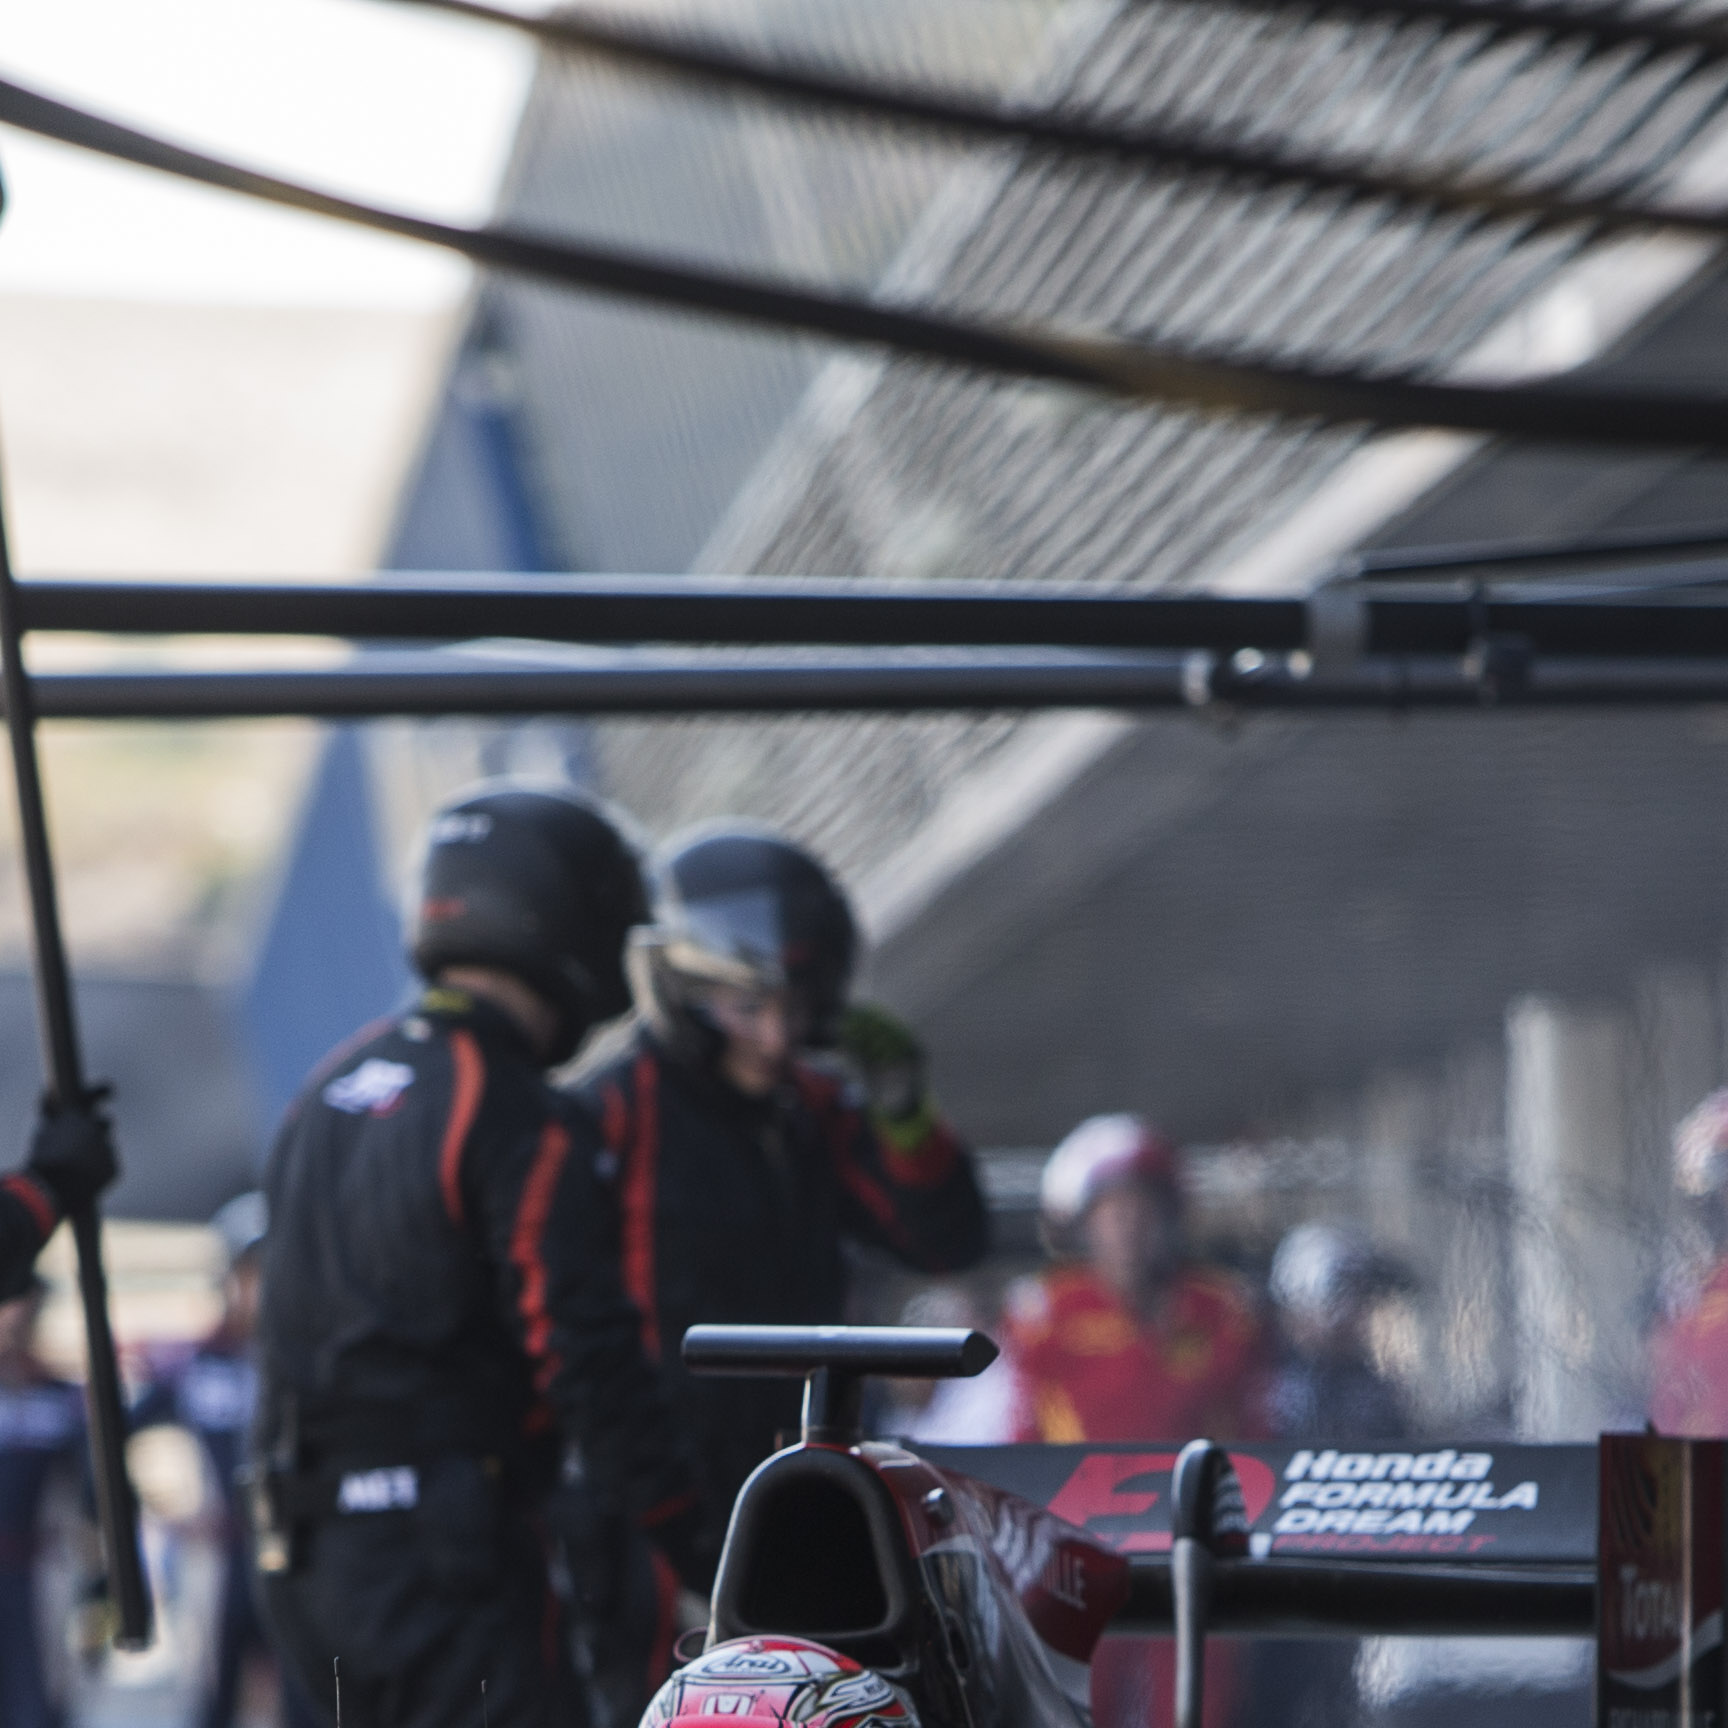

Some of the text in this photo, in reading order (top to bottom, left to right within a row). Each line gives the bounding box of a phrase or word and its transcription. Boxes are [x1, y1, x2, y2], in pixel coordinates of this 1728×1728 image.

[1284, 1449, 1494, 1481] Honda
[1278, 1481, 1539, 1511] FORMULA
[1273, 1508, 1478, 1535] DREAM
